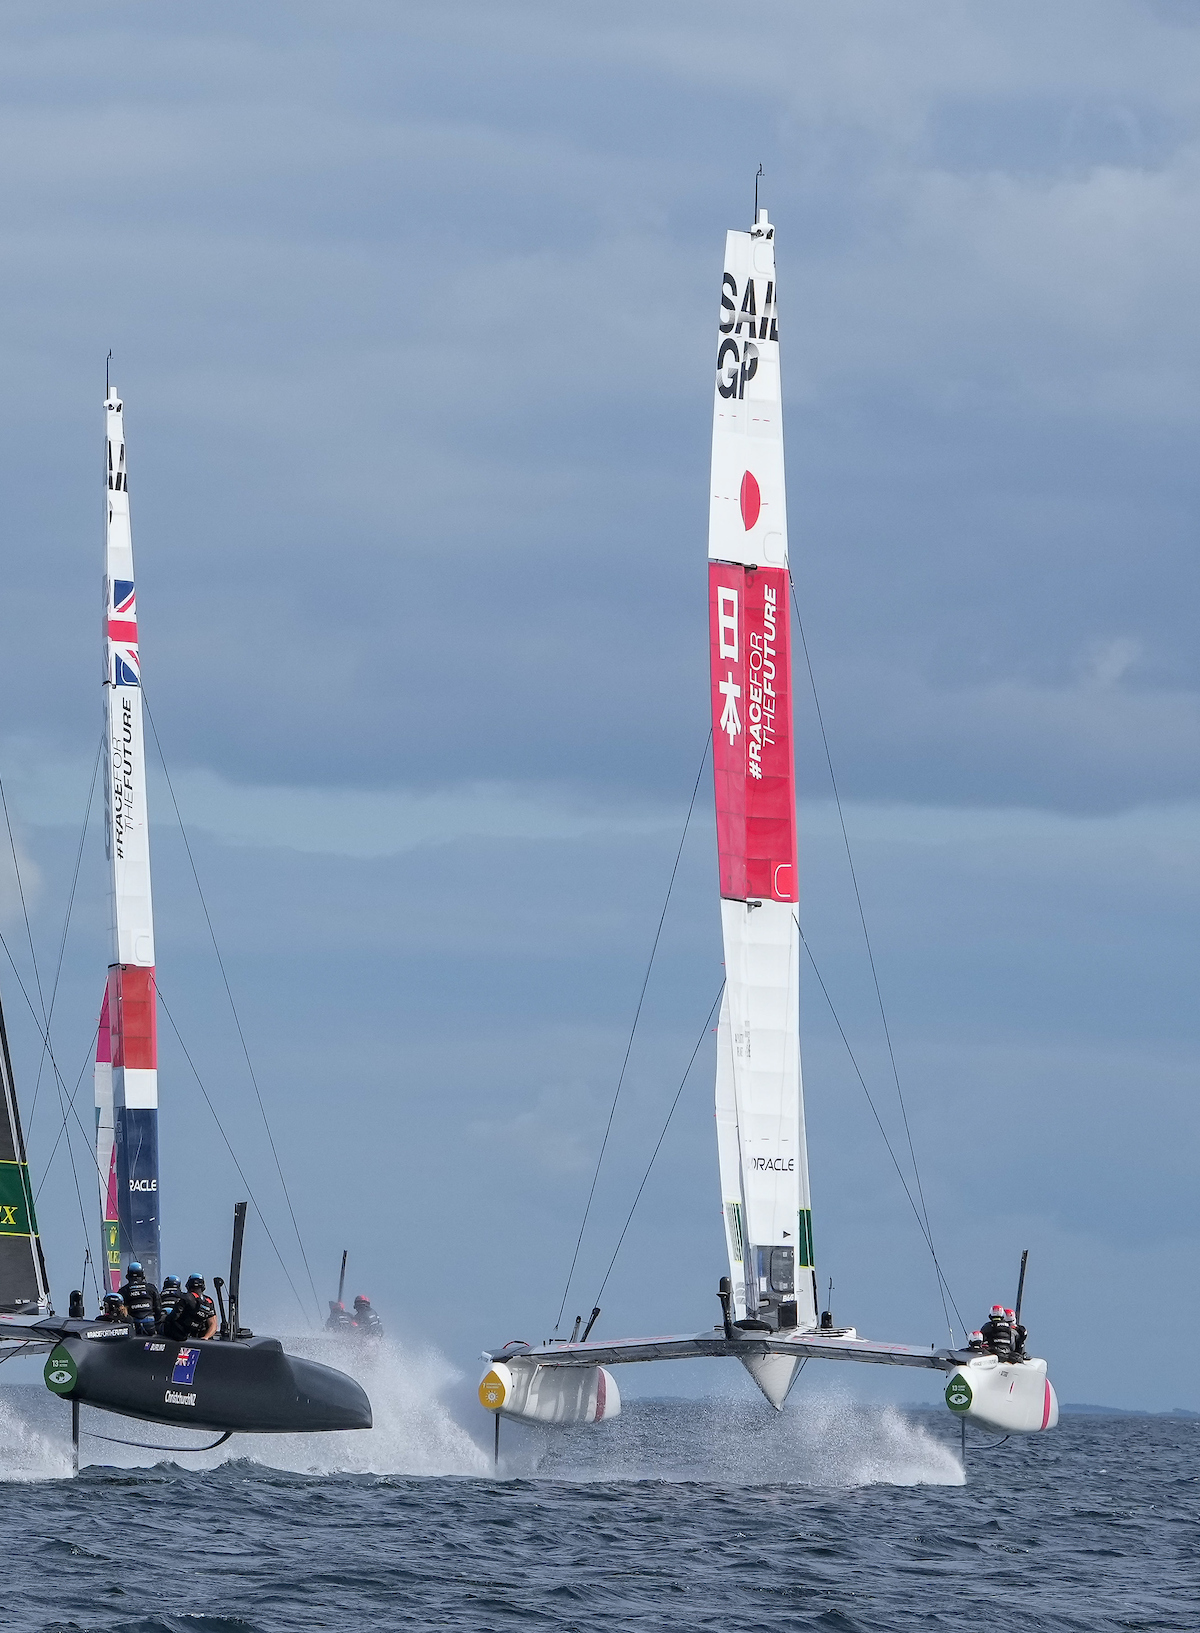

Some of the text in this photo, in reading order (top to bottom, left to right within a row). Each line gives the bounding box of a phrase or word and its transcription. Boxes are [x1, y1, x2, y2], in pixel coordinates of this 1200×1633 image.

[719, 272, 779, 342] SAIL
[717, 338, 760, 400] GP
[717, 586, 742, 746] 日本
[129, 1179, 157, 1191] RACLE
